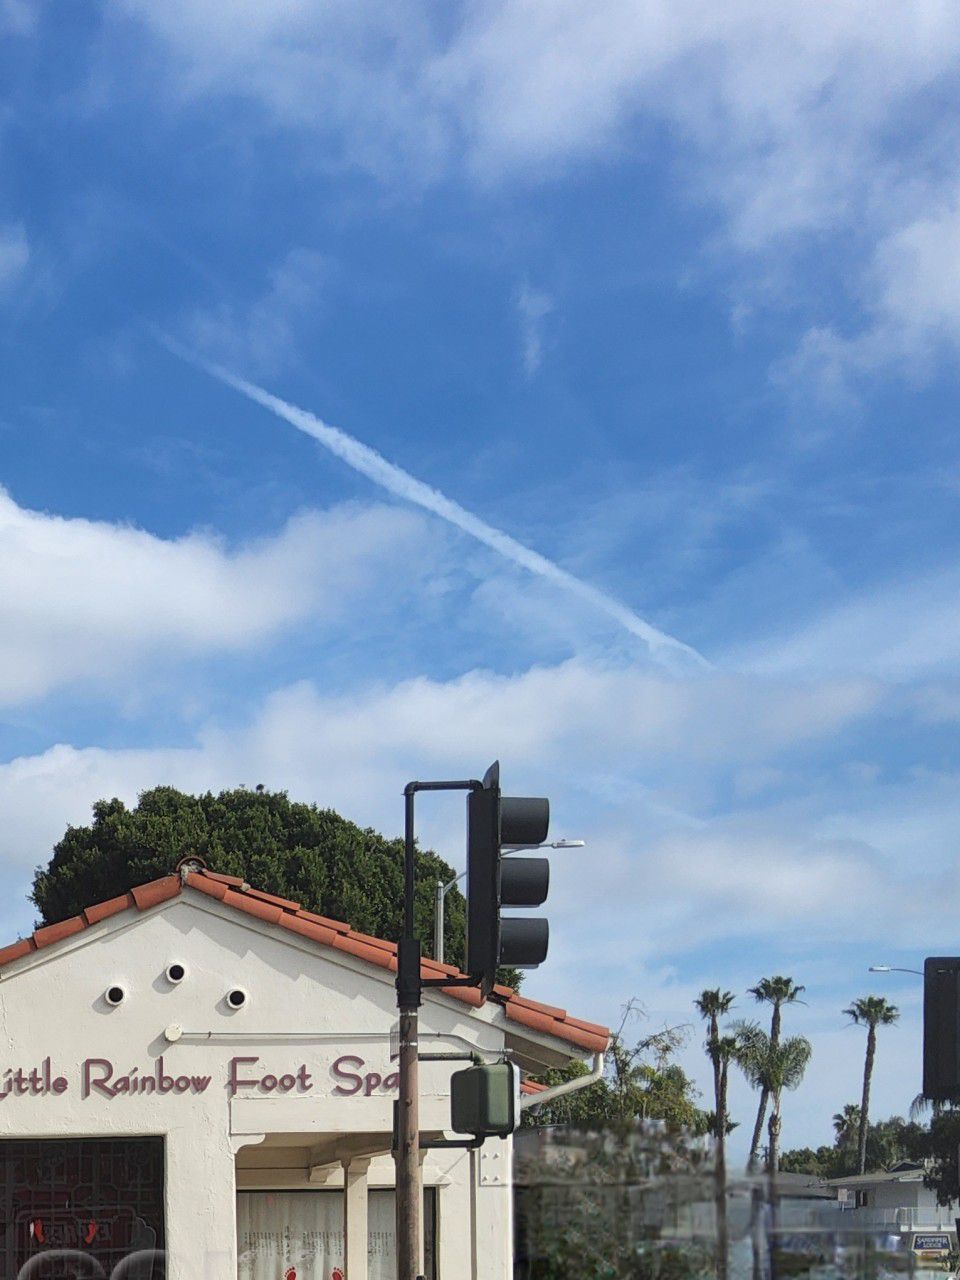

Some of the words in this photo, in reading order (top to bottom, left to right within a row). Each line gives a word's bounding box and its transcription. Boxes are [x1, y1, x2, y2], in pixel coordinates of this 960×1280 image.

[81, 1056, 212, 1100] Rainbow
[225, 1056, 313, 1096] Foot
[330, 1055, 400, 1096] Spa
